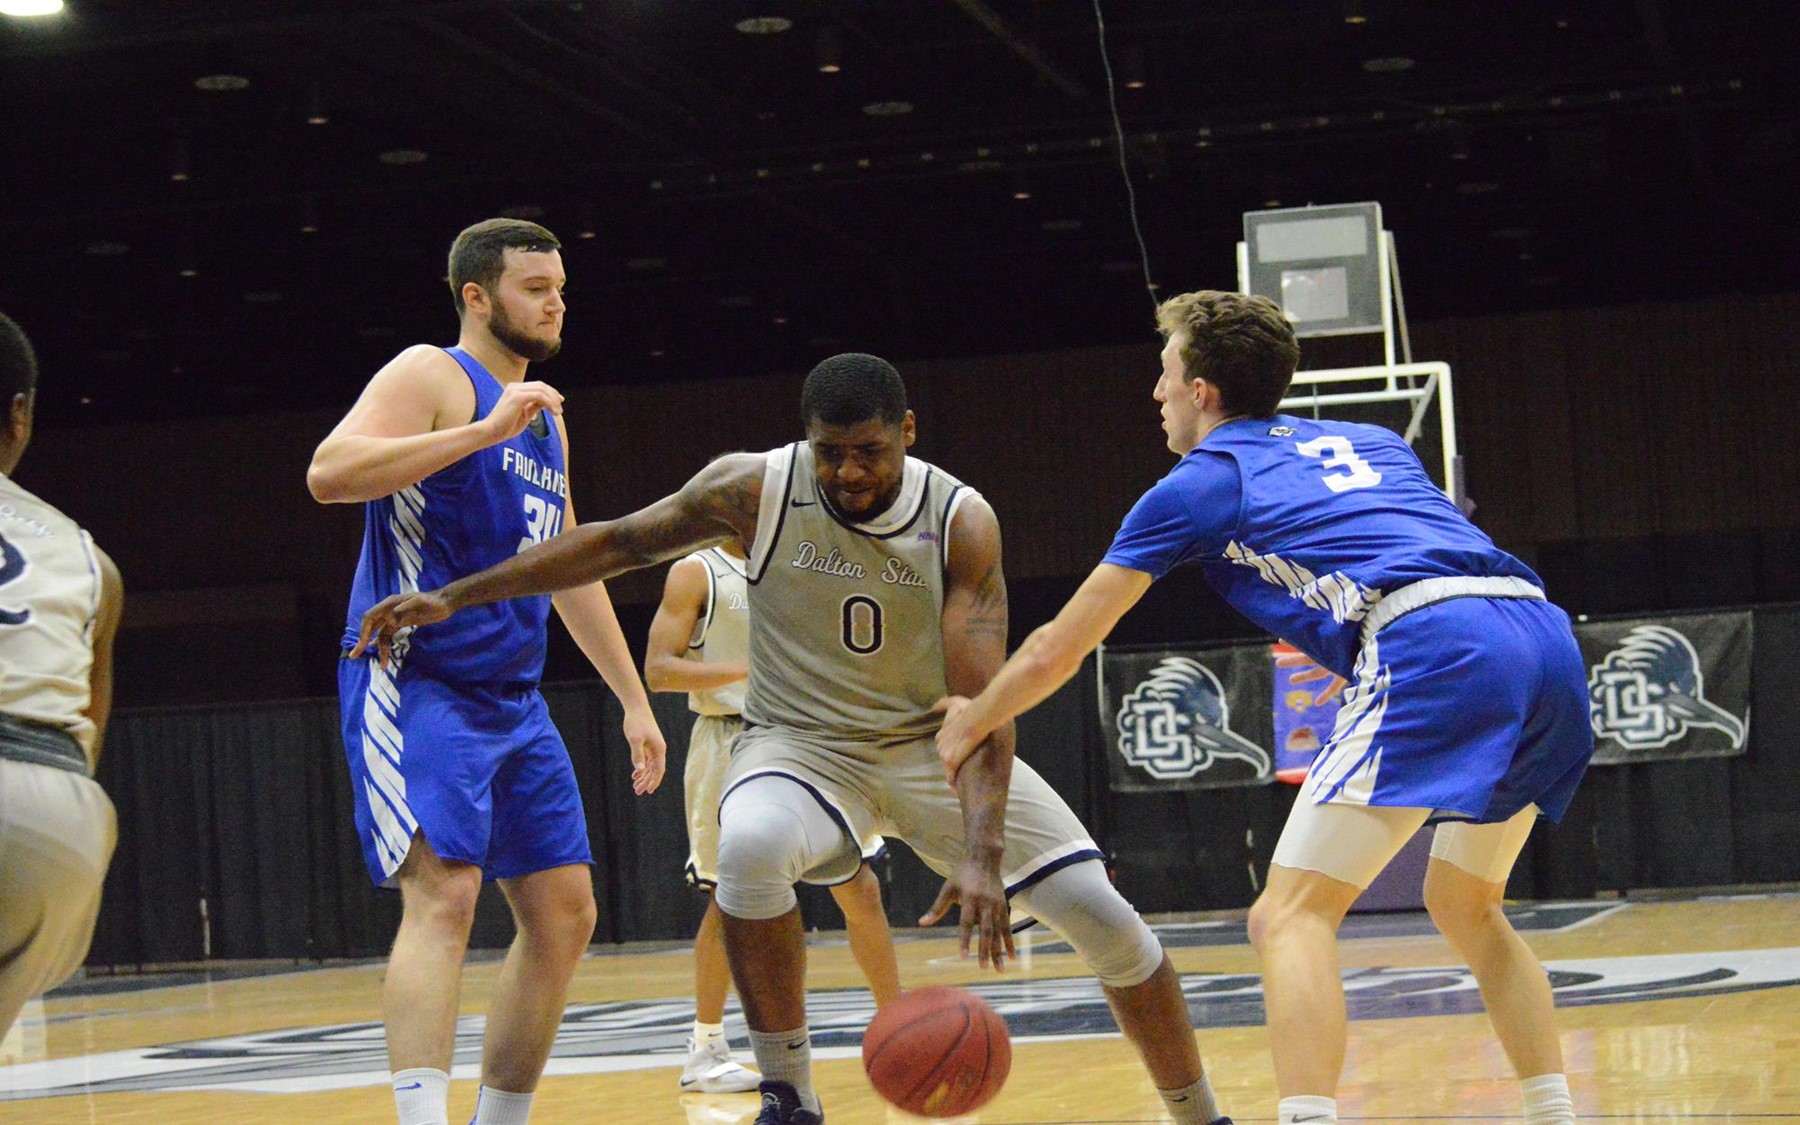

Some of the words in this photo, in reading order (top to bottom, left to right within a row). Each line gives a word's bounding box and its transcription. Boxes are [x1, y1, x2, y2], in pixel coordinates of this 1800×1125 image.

[502, 446, 567, 500] FAULKNE
[1295, 436, 1382, 493] 3
[791, 540, 866, 579] Dalton
[881, 556, 928, 588] Sta
[840, 593, 885, 656] 0
